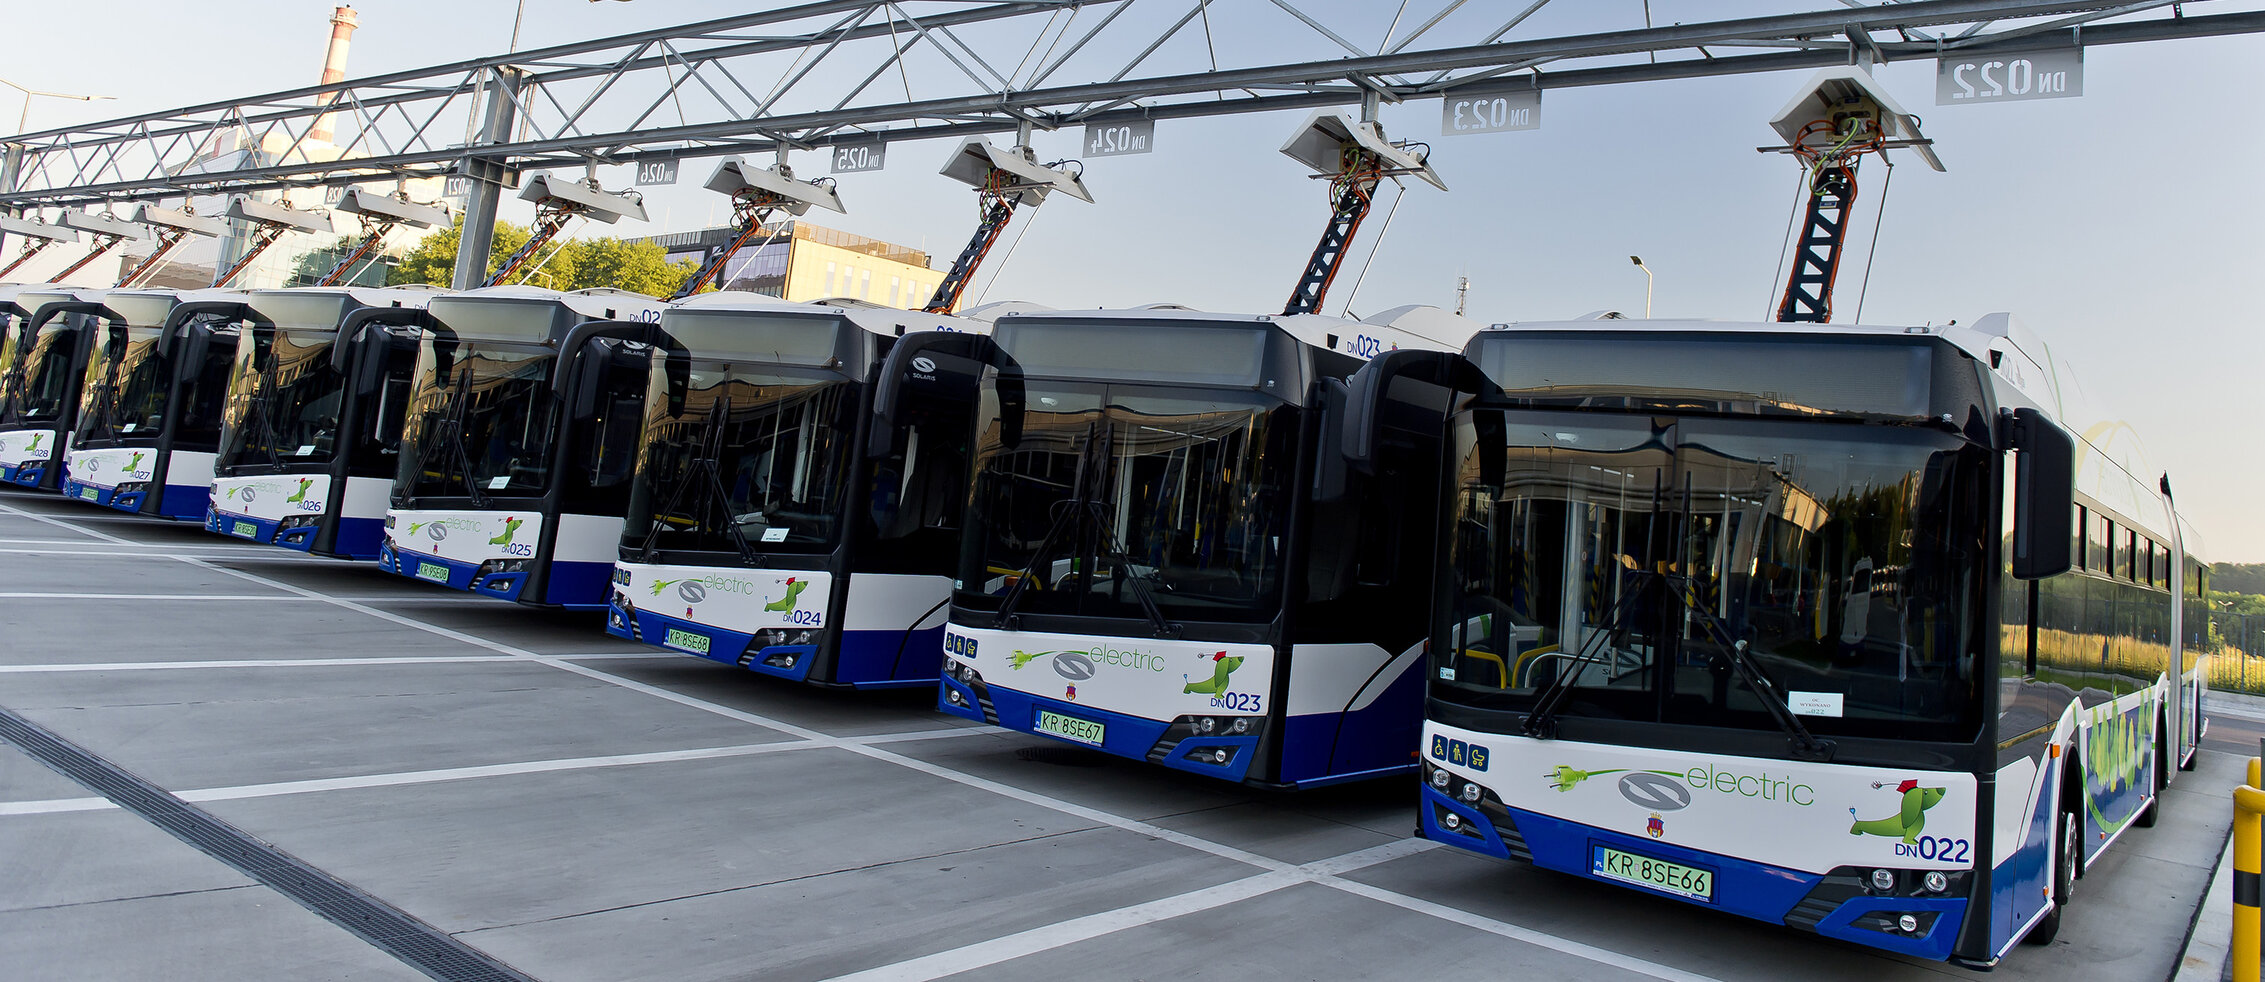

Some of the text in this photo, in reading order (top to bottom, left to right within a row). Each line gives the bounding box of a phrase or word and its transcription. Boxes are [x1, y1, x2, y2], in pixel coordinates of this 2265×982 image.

[629, 309, 661, 324] DN02
[912, 372, 936, 382] SOLARIS
[446, 515, 481, 533] electric
[704, 572, 754, 595] electric
[670, 630, 708, 650] KR 8SE68
[1090, 643, 1165, 672] electric
[1042, 713, 1101, 740] KR 8SE67
[1687, 763, 1814, 806] electric
[1607, 851, 1705, 893] KR 8SE66
